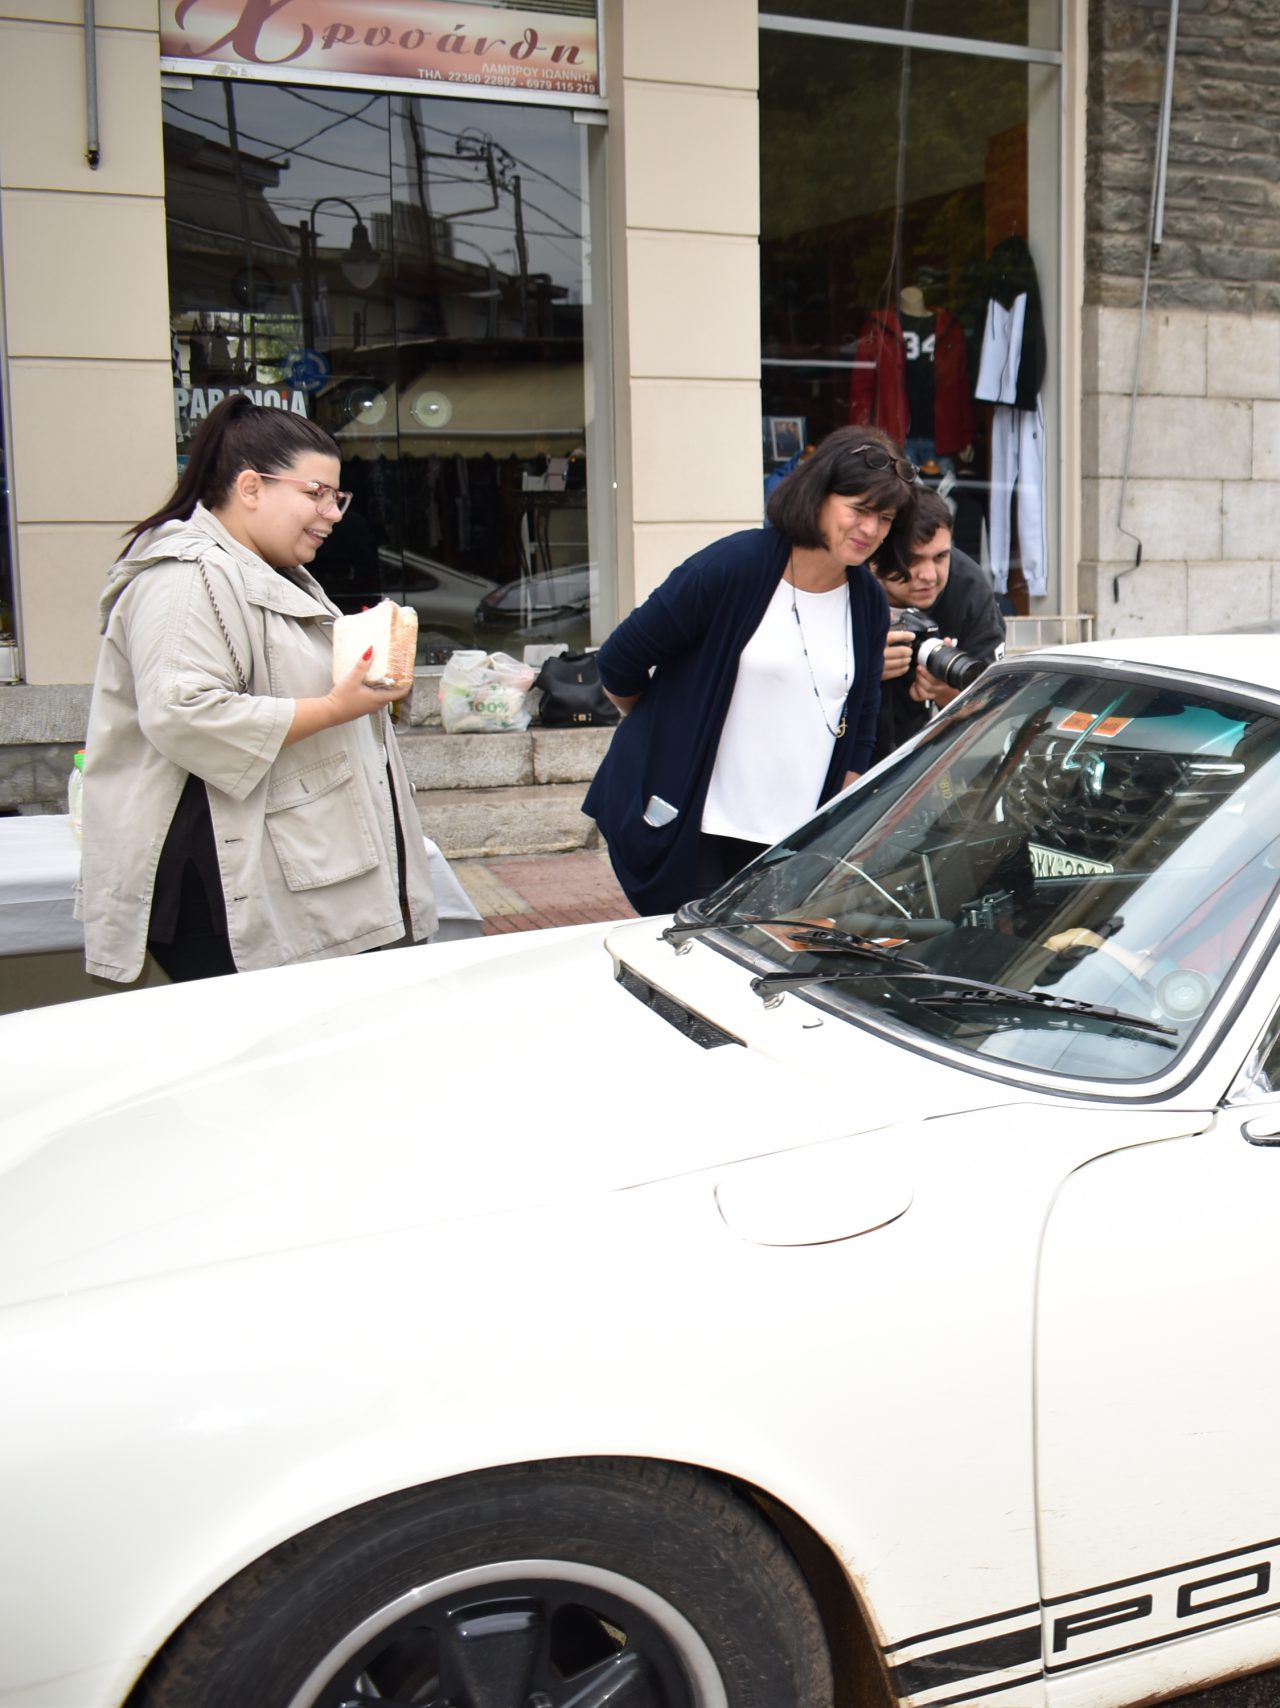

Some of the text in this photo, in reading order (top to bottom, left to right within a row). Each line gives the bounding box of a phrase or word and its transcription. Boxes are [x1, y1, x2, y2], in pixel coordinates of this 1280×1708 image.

[417, 68, 445, 81] ΤΗΛ.
[555, 80, 574, 92] 115
[576, 83, 596, 94] 219
[481, 63, 593, 83] ΛΑΜΠΡΟΥ ΙΩΑΝΝΗΣ
[902, 331, 936, 362] 34
